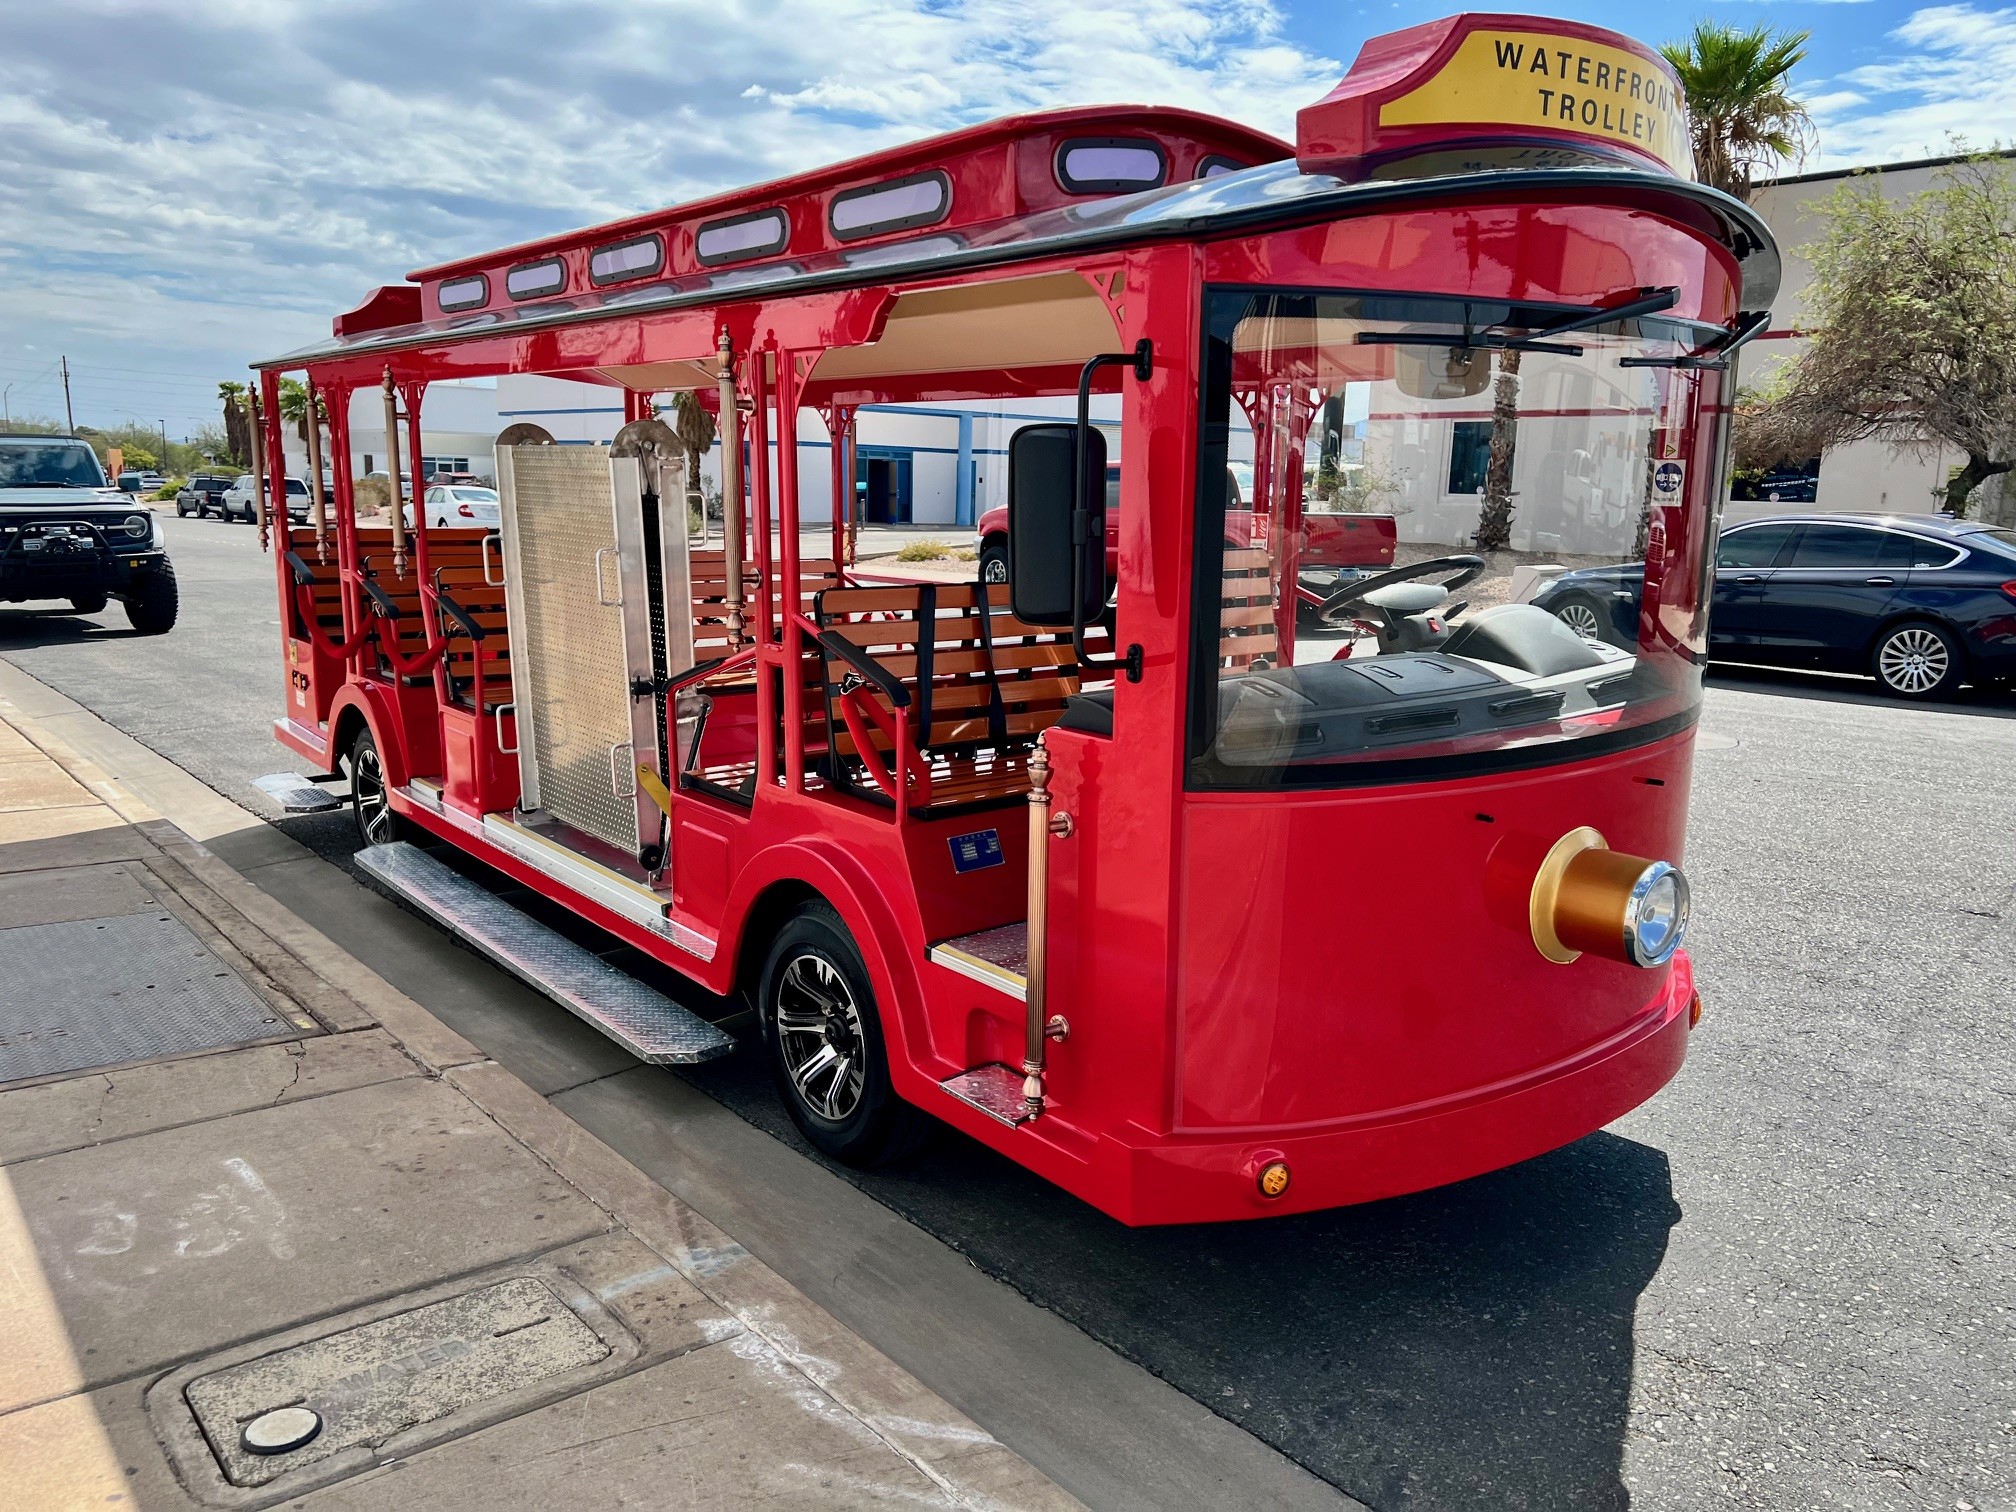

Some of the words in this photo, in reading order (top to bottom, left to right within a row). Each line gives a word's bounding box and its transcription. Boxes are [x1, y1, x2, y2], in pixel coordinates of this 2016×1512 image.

[1495, 40, 1675, 116] WATERFRONT
[1539, 89, 1656, 142] TROLLEY
[337, 1340, 472, 1390] WATER
